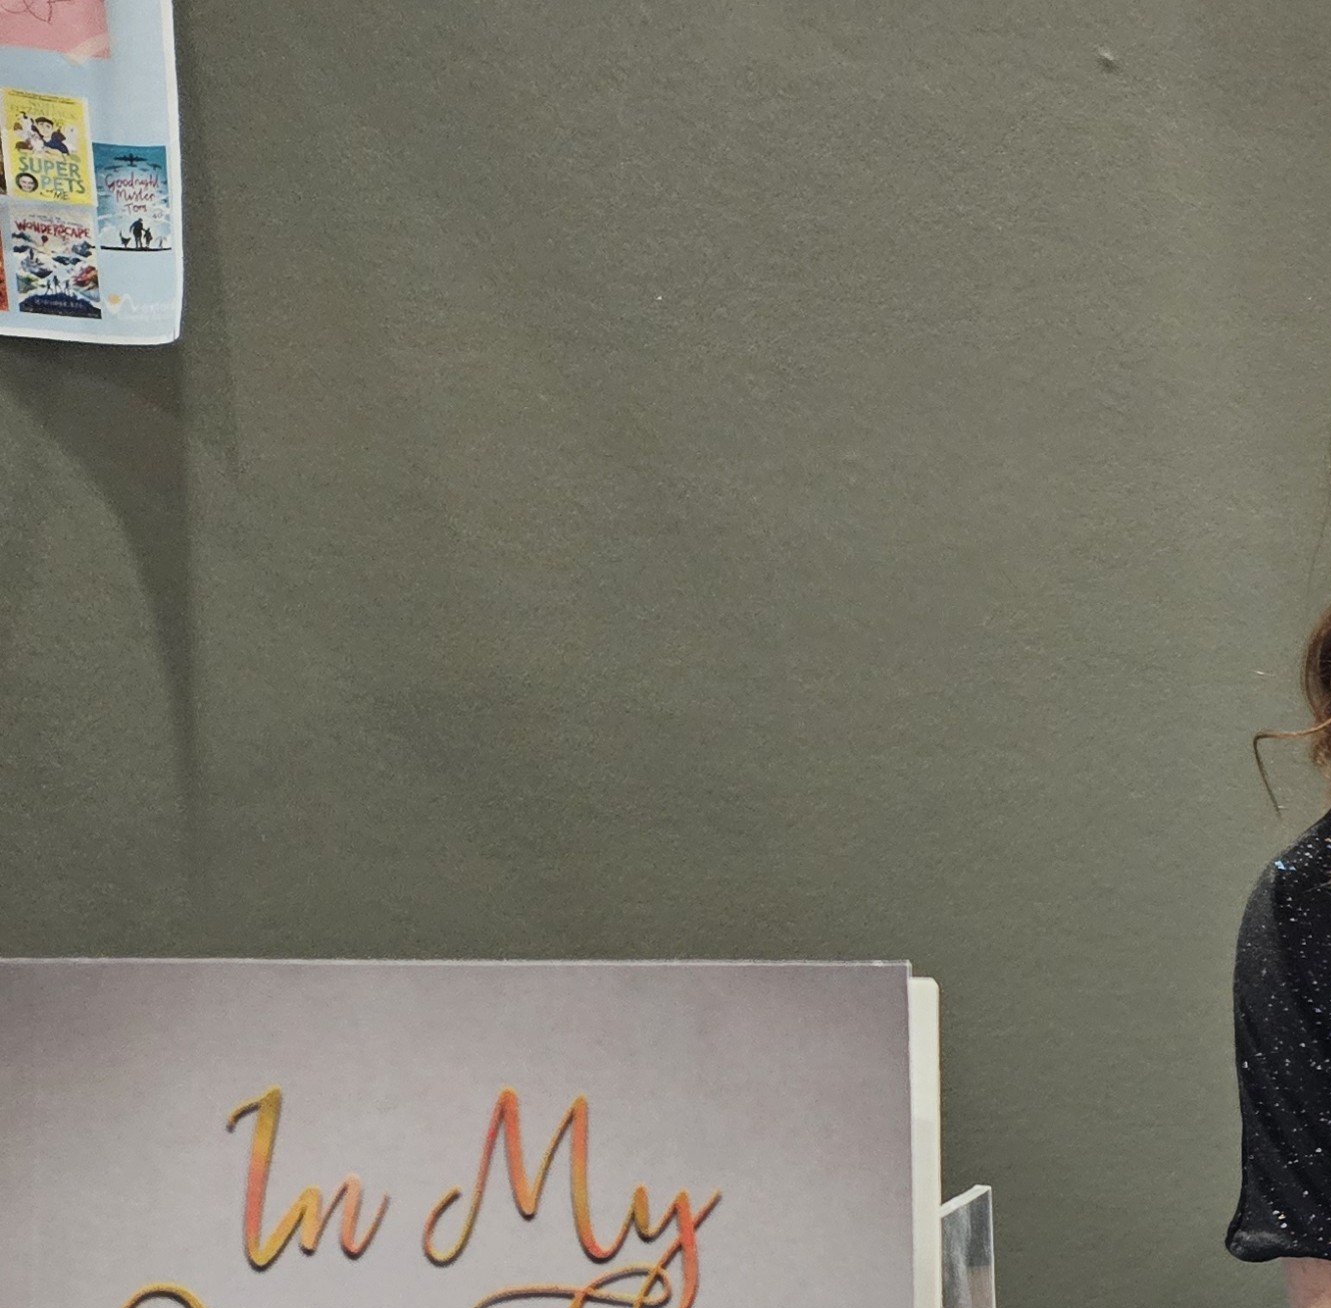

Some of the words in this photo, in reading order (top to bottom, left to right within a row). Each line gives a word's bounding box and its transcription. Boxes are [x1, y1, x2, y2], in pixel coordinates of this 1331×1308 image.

[19, 156, 81, 178] SUPER
[41, 175, 86, 194] PETS
[226, 1085, 390, 1269] In
